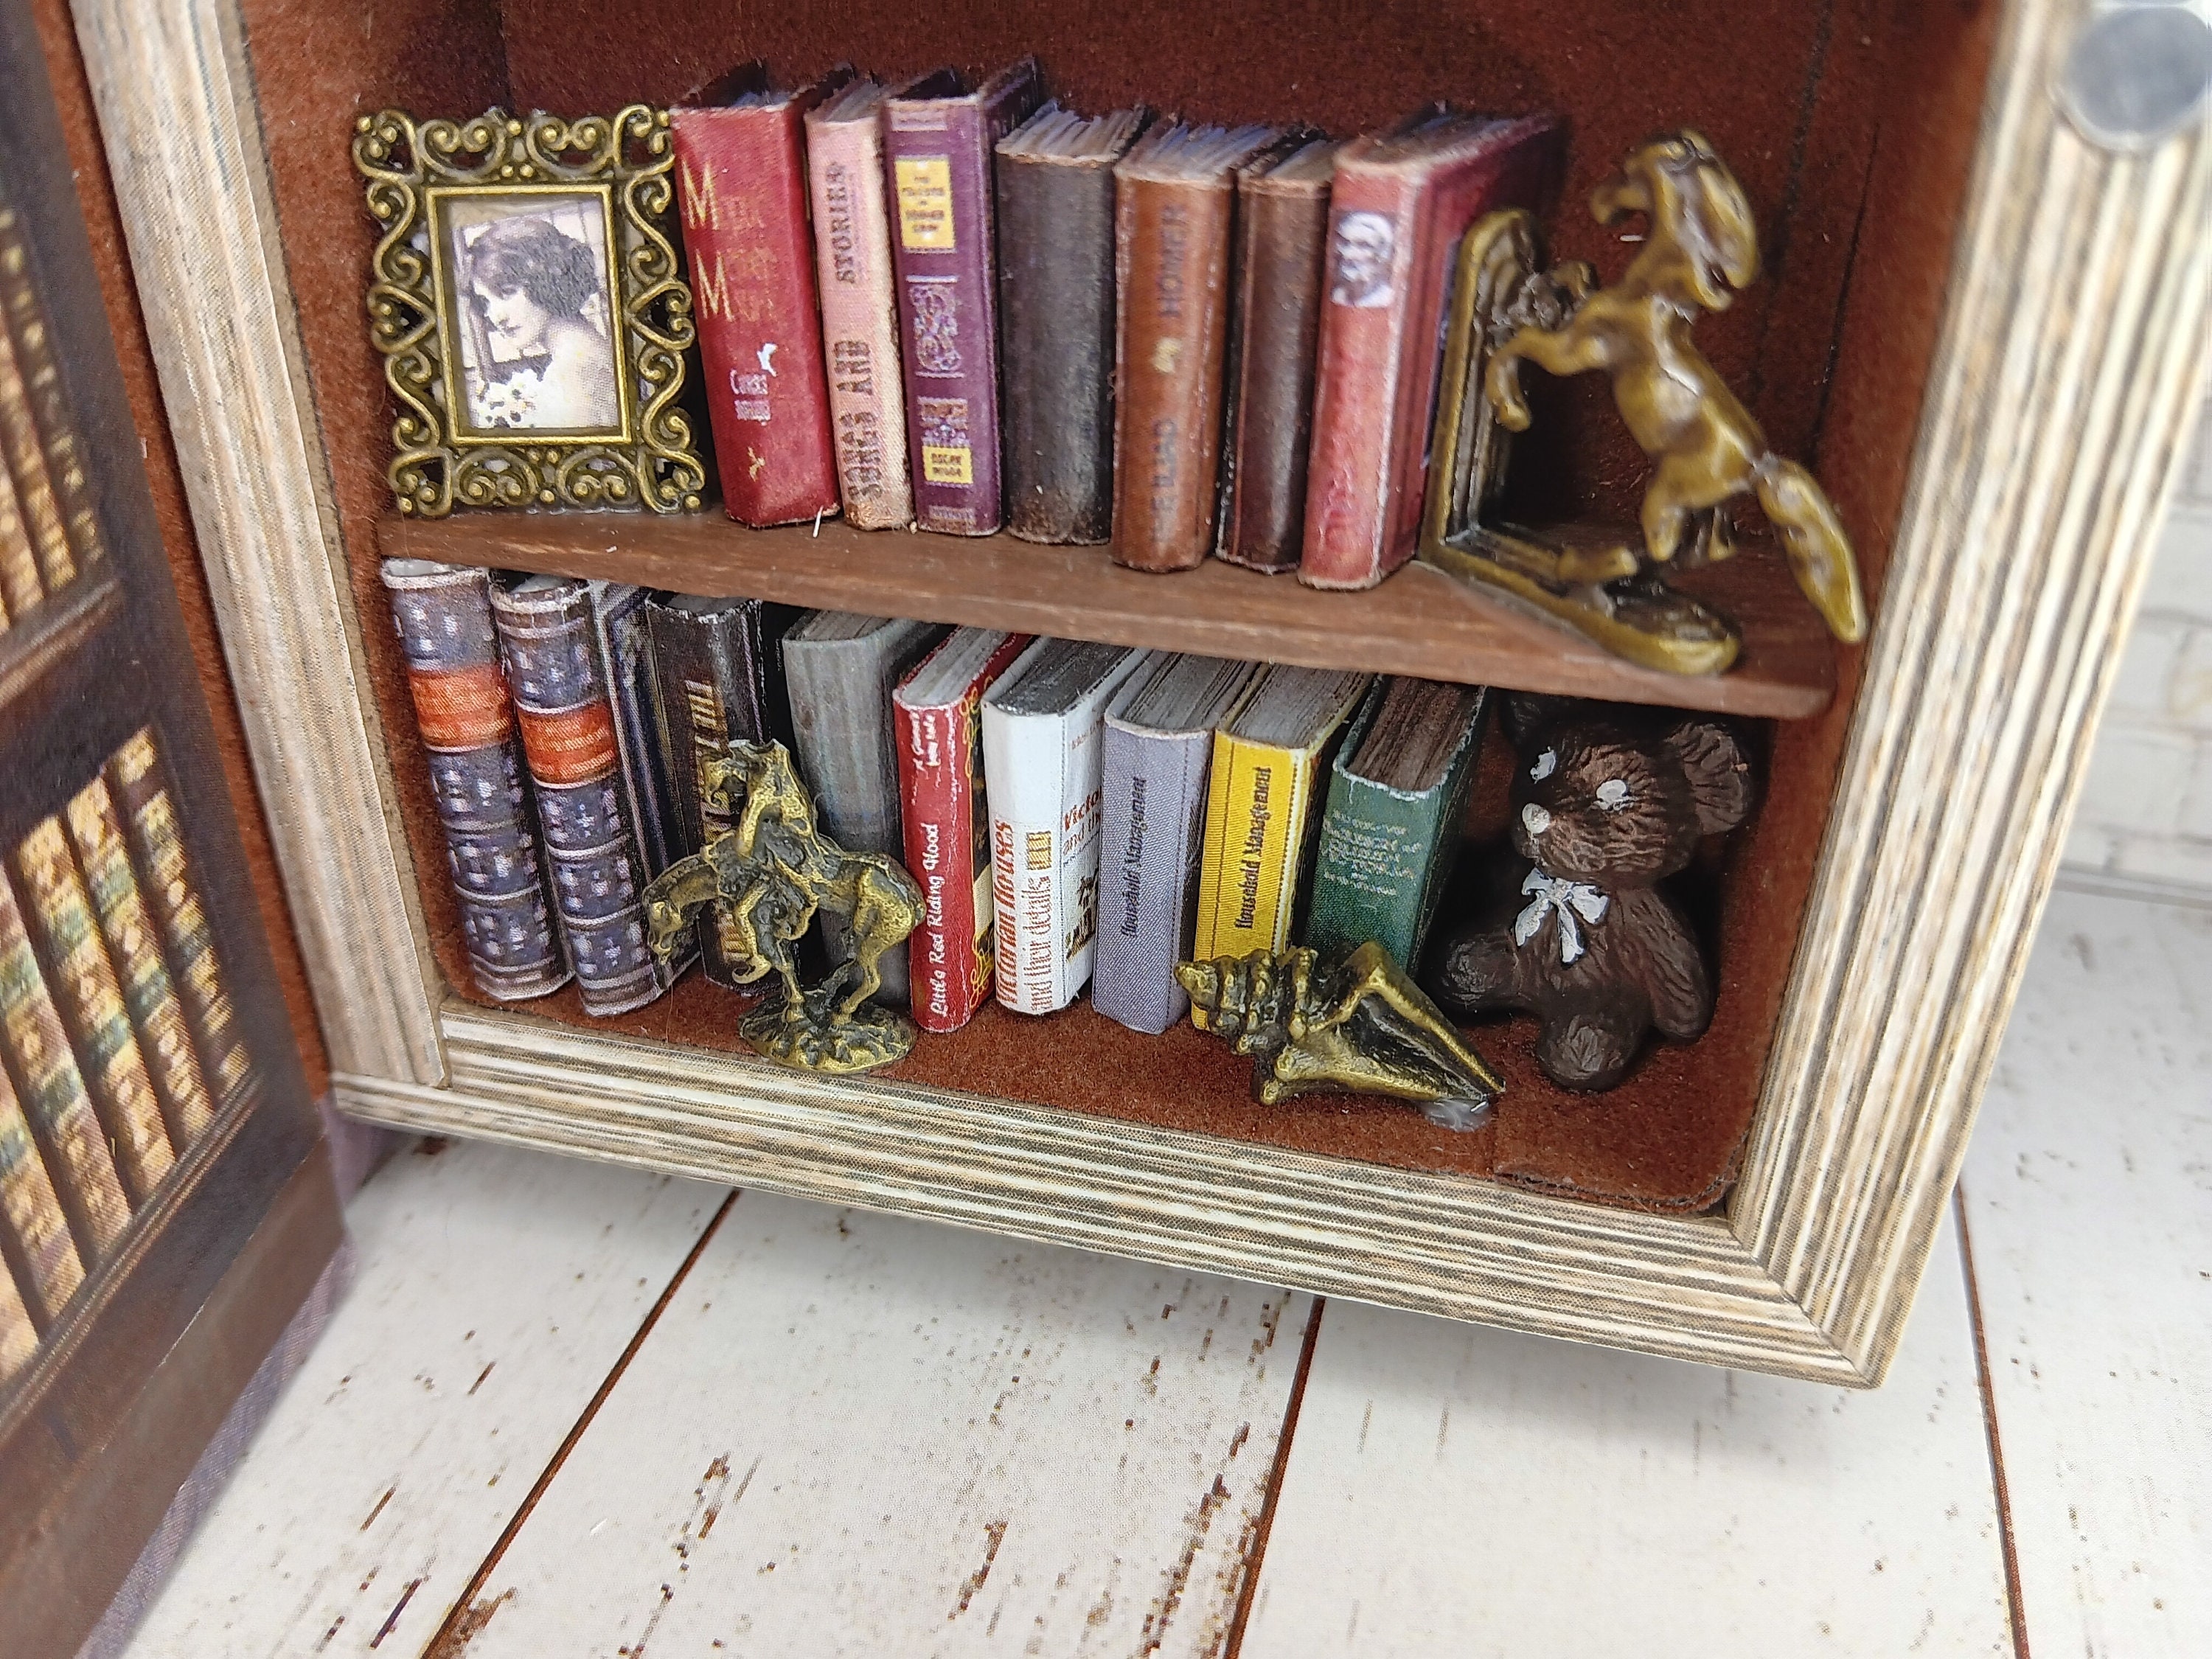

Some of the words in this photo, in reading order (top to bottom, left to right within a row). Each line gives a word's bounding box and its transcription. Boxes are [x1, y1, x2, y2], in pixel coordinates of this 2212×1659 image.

[825, 162, 856, 285] STORIES
[832, 339, 873, 396] AND
[922, 823, 939, 870] Hood
[994, 818, 1015, 910] Houses
[926, 875, 945, 927] Riding
[1021, 875, 1051, 936] details
[928, 933, 946, 964] Red
[996, 909, 1017, 1005] Victorian
[1023, 940, 1051, 977] their
[930, 970, 949, 1018] Little
[1024, 981, 1053, 1011] and
